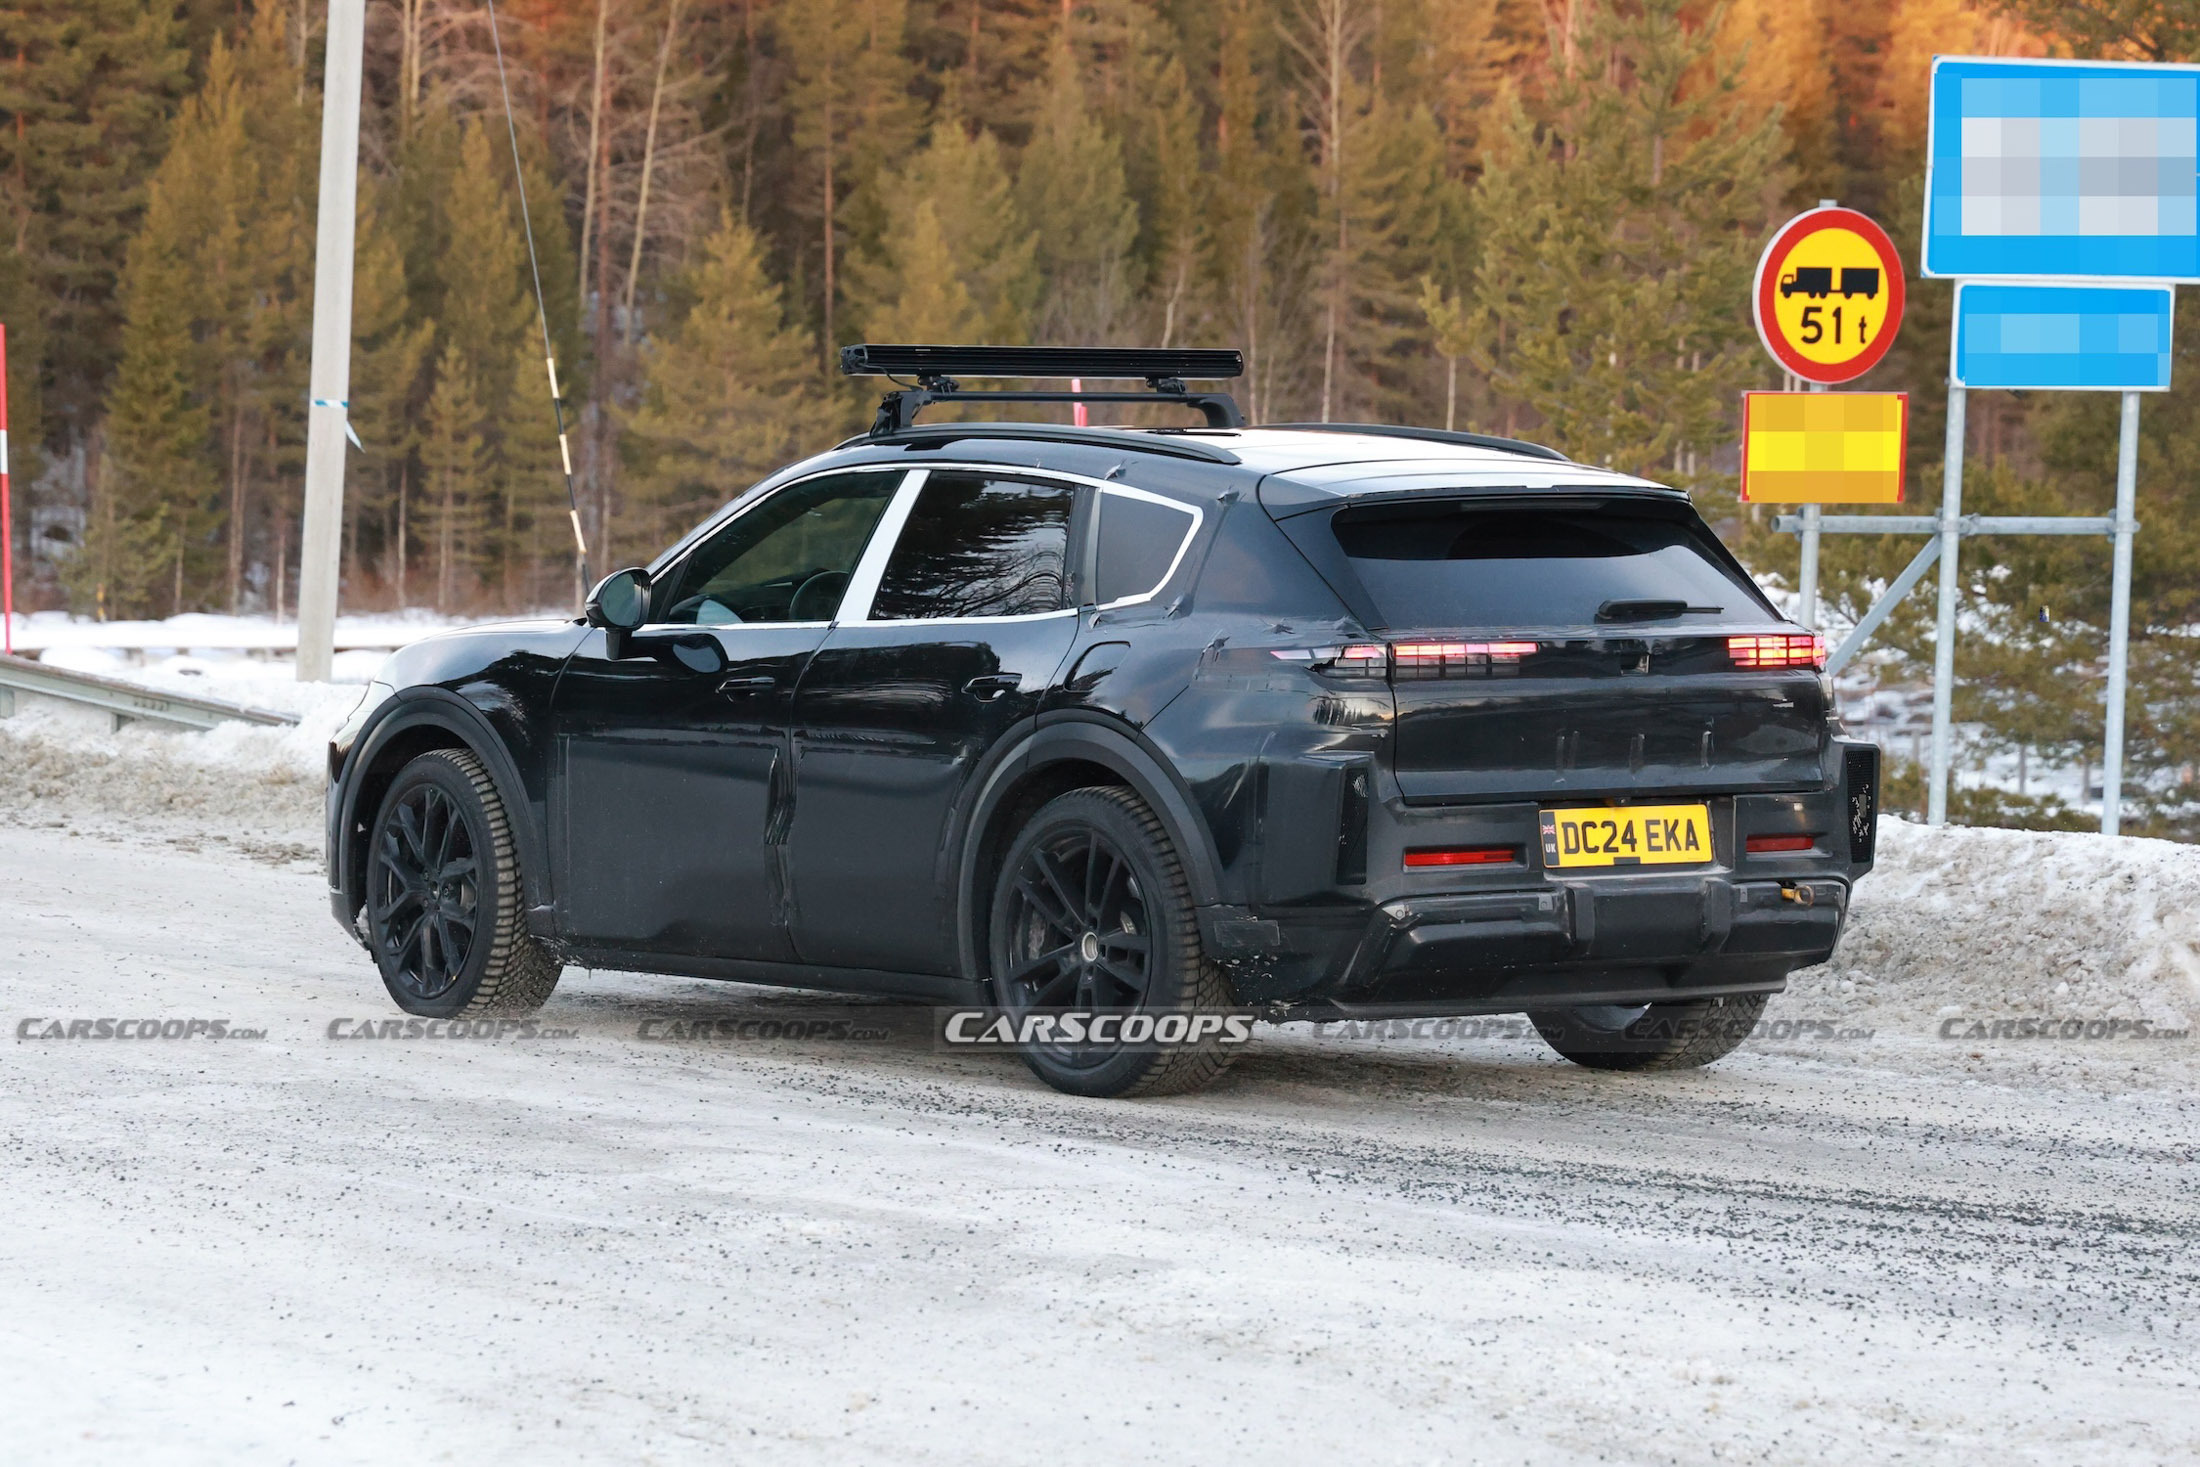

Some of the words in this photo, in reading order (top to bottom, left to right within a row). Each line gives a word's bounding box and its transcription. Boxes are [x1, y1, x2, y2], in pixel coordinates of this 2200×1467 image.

[1801, 306, 1842, 344] 51
[1858, 315, 1867, 344] t
[1545, 843, 1557, 853] UK
[1561, 820, 1638, 854] DC24
[1645, 819, 1700, 851] EKA
